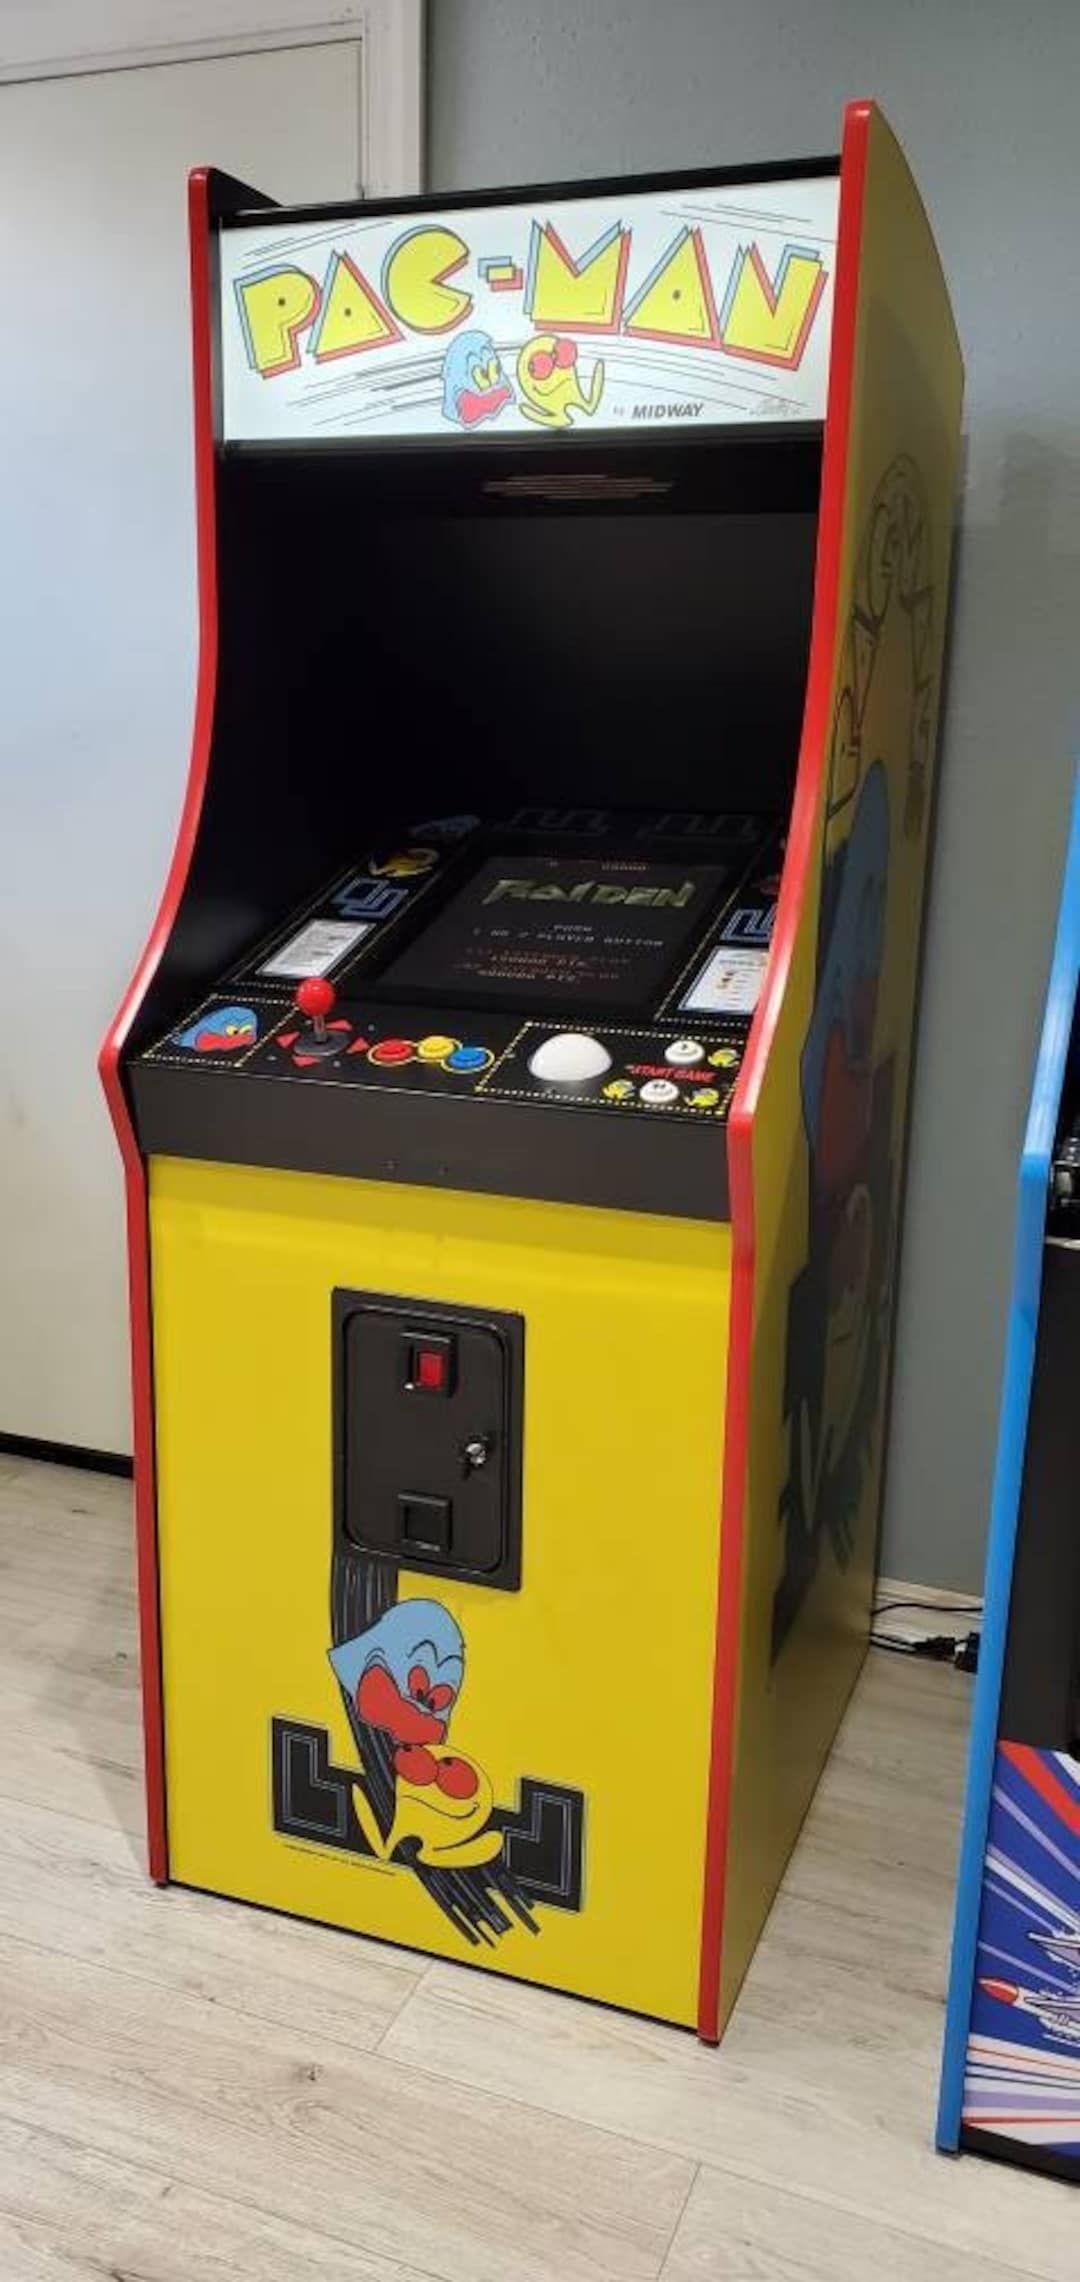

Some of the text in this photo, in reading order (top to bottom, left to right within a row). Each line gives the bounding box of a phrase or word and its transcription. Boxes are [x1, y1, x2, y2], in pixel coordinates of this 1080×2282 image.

[233, 218, 829, 380] PAC-MAN
[630, 402, 704, 420] MIDWAY
[480, 879, 696, 908] RAIDEN
